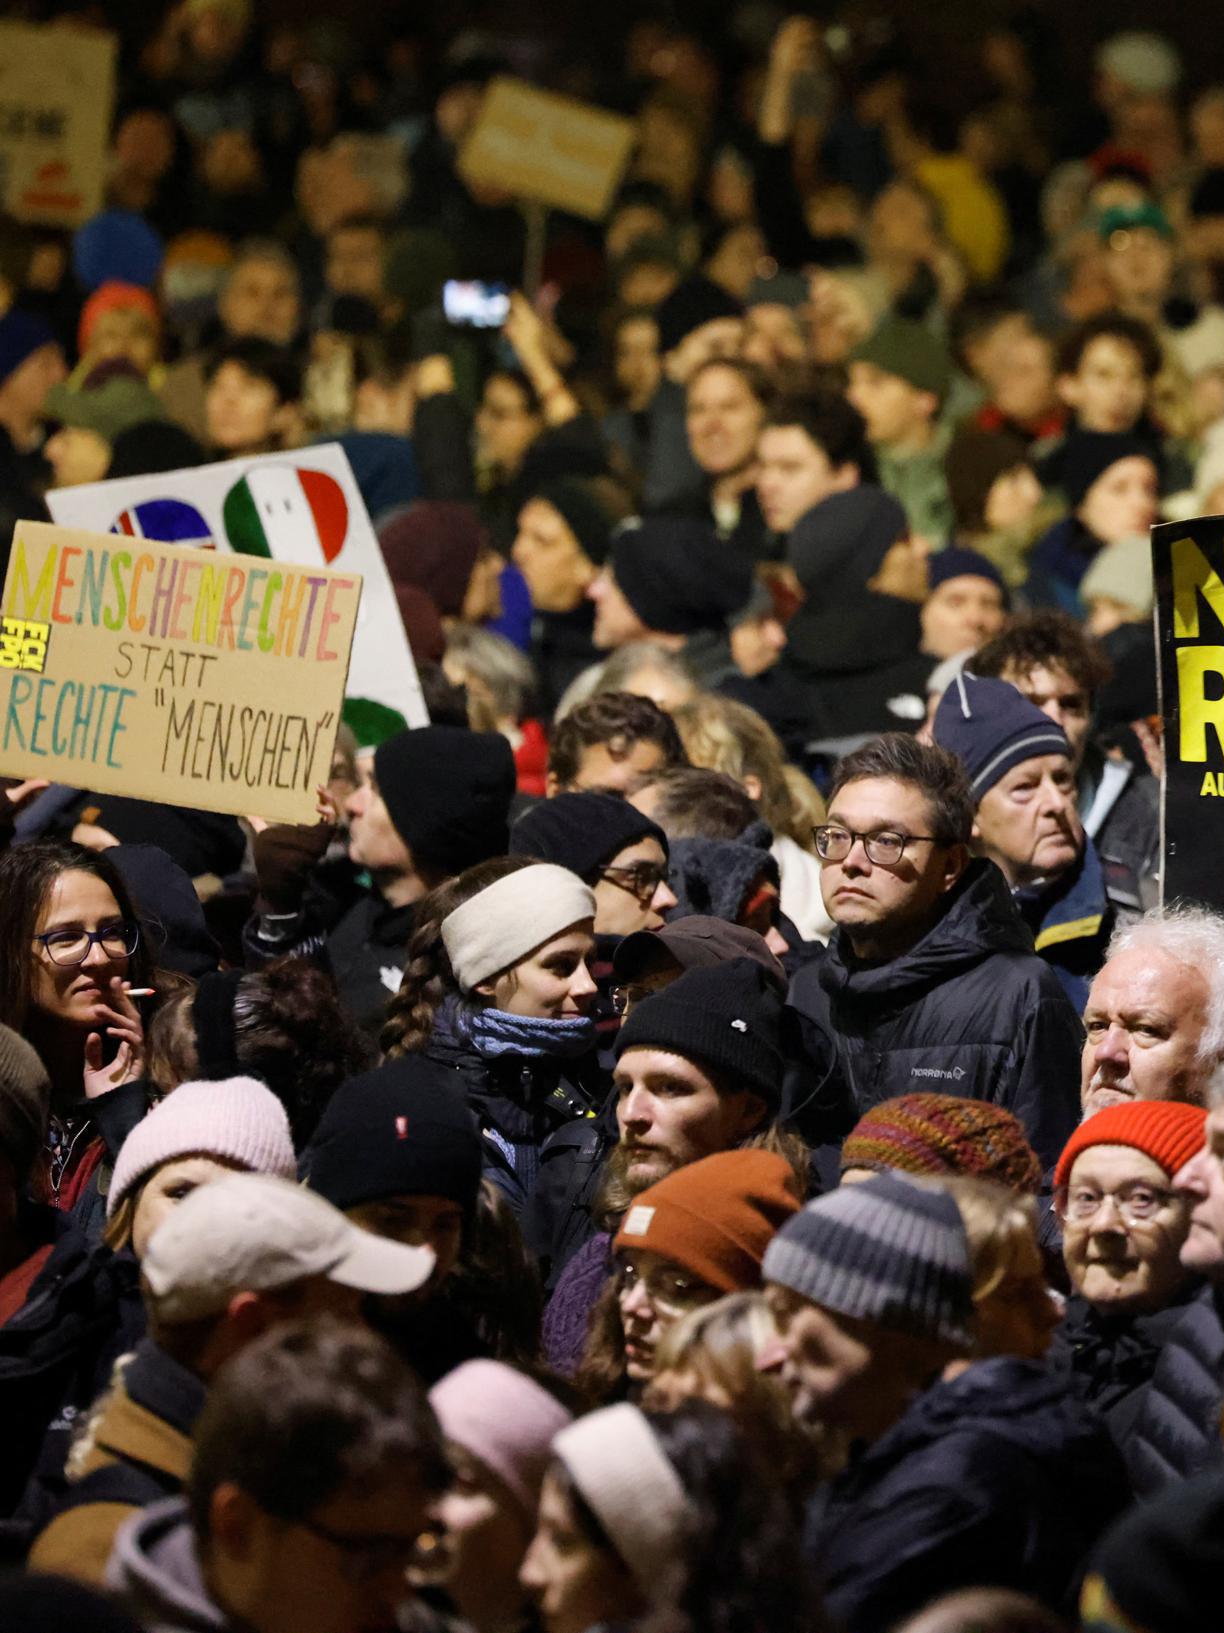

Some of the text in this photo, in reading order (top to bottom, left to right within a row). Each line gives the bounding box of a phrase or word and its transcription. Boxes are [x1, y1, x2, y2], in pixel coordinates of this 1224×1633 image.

[6, 540, 354, 661] MENSCHENRECHTE
[114, 641, 218, 688] STATT
[2, 675, 137, 770] RECHTE
